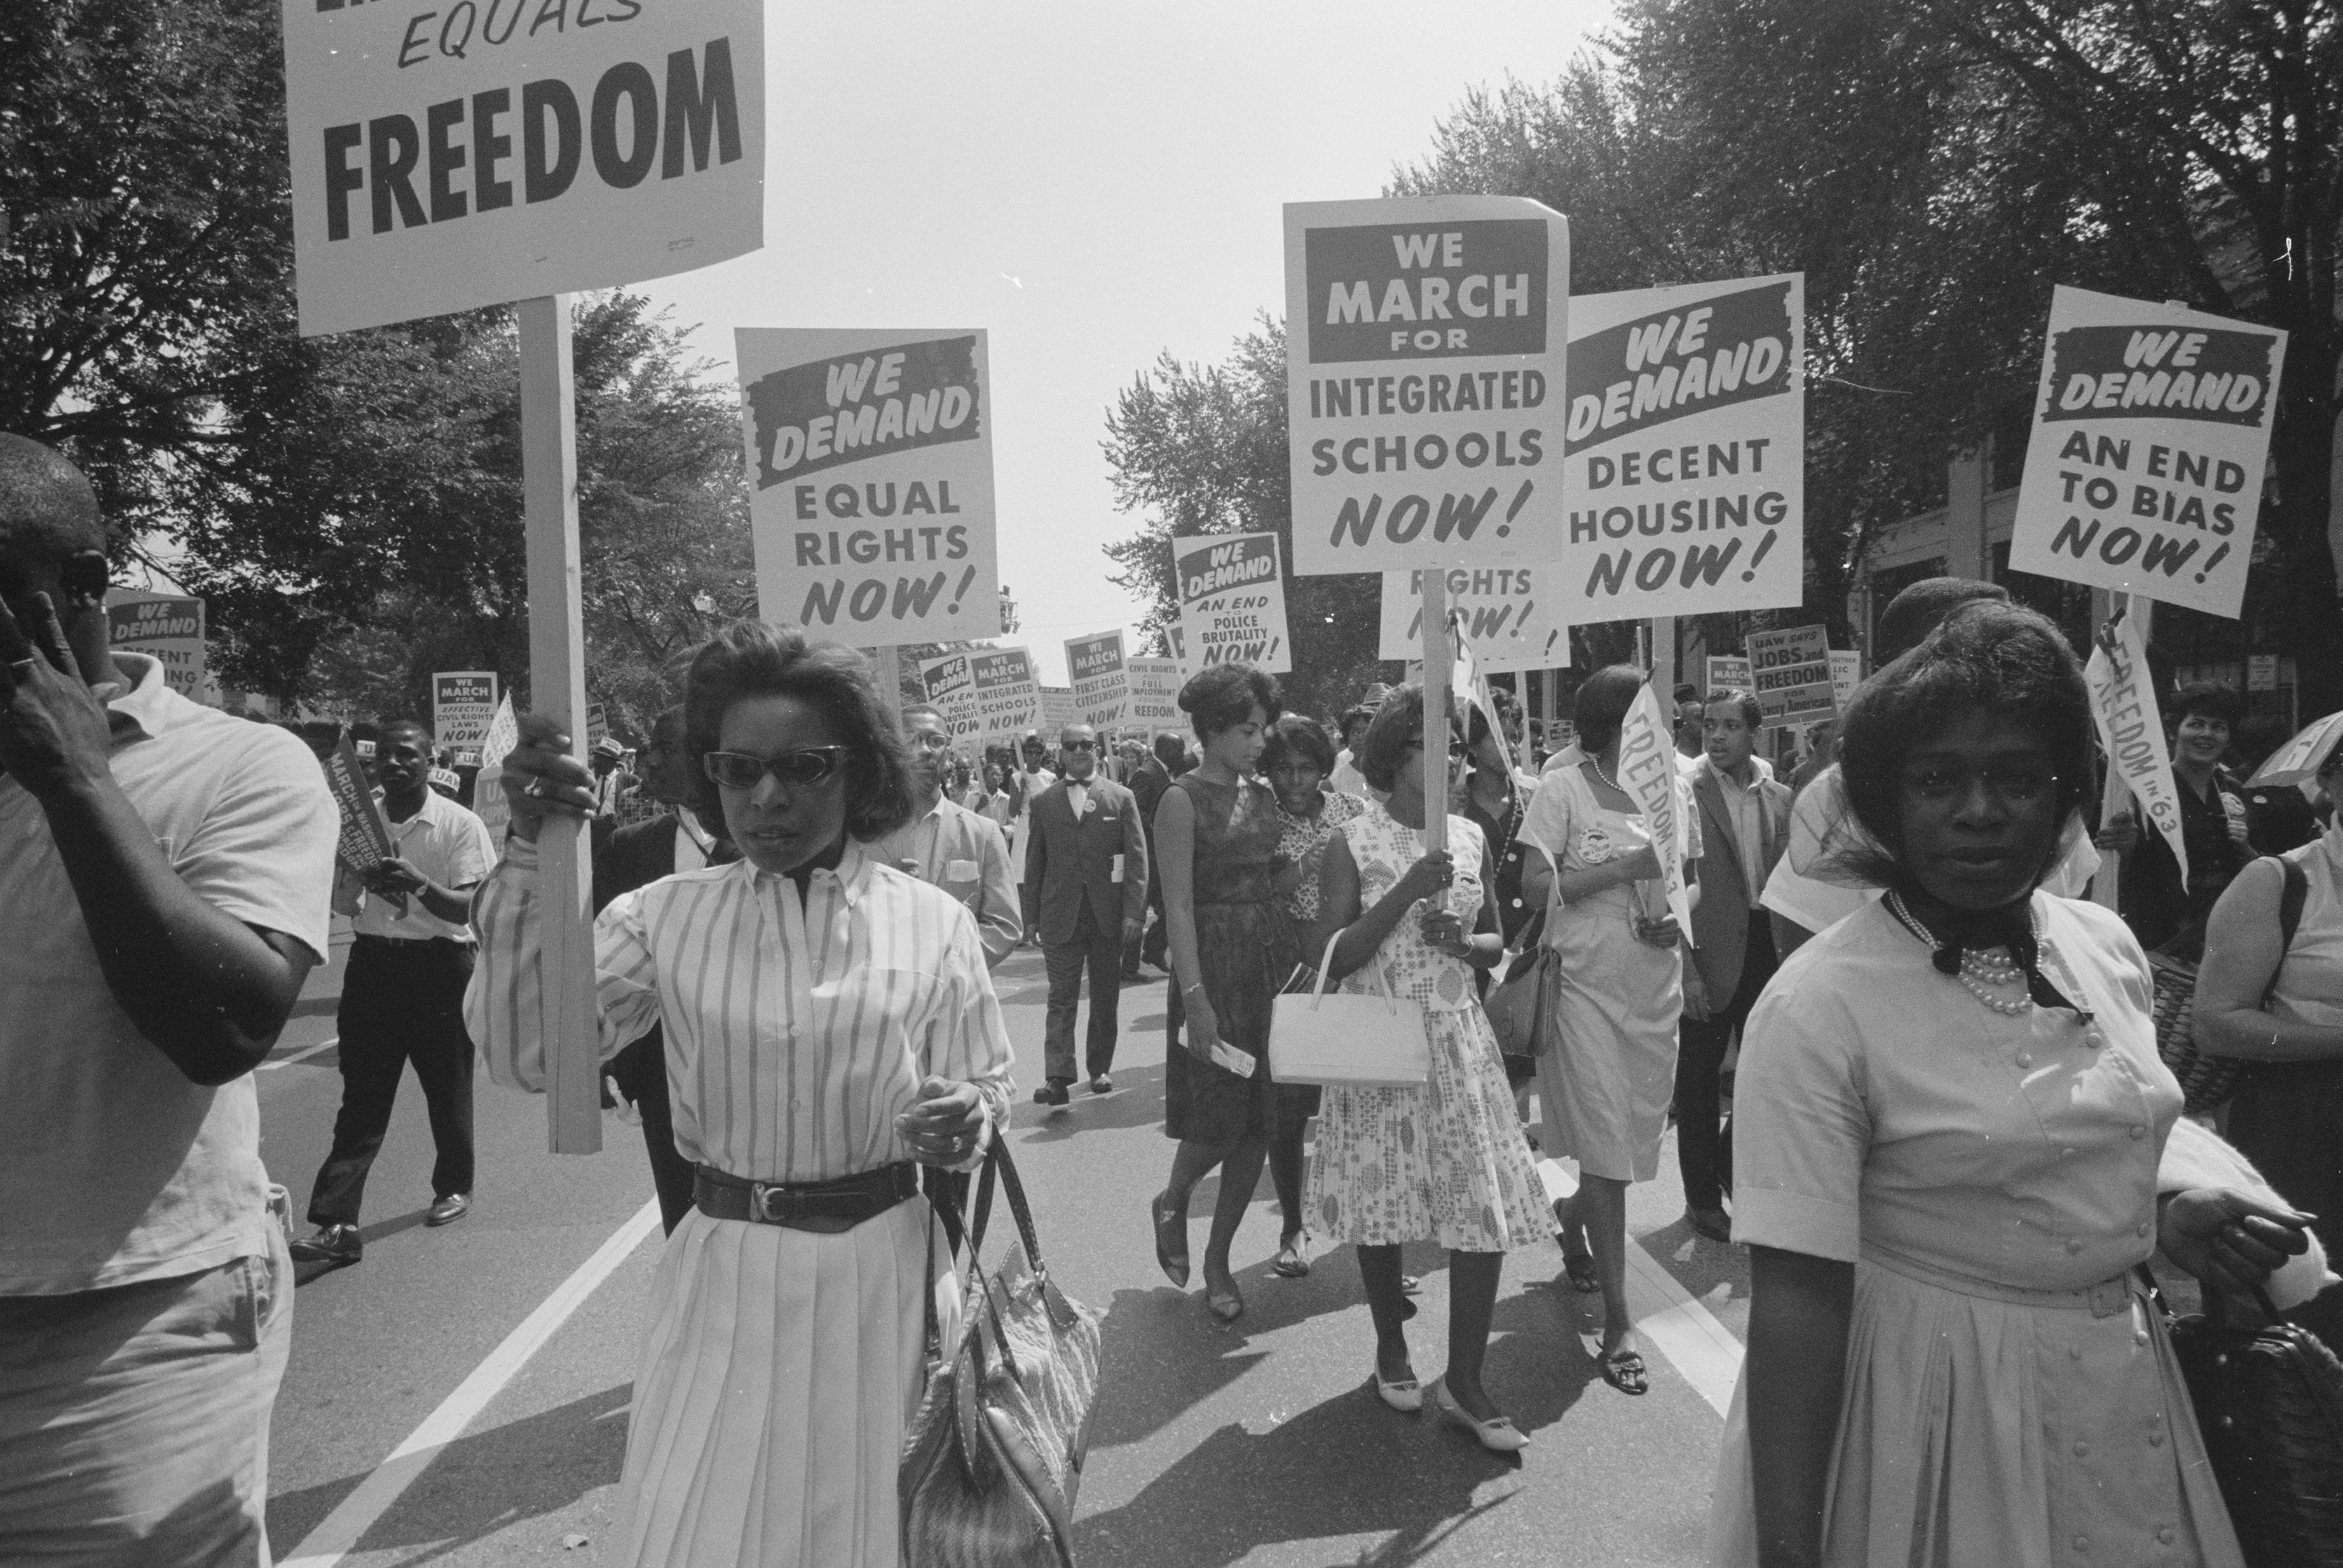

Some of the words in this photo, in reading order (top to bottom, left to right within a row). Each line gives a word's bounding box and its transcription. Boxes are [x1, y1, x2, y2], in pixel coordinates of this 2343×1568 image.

[324, 36, 742, 242] FREEDOM
[1392, 232, 1463, 270] WE
[1325, 273, 1529, 325] MARCH
[1391, 328, 1470, 351] FOR
[1625, 307, 1713, 372] WE
[2123, 330, 2208, 369] WE
[826, 352, 906, 408] WE
[1566, 337, 1784, 442] DEMAND
[2060, 371, 2262, 412] DEMAND
[1309, 369, 1547, 419] INTEGRATED
[772, 386, 972, 472] DEMAND
[1311, 428, 1544, 477] SCHOOLS
[1588, 438, 1770, 490] DECENT
[2059, 430, 2131, 471] AN
[2147, 445, 2245, 494] END
[795, 481, 960, 520] EQUAL
[2059, 470, 2118, 510] TO
[2131, 484, 2236, 536] BIAS
[1329, 479, 1534, 549] NOW!
[1570, 491, 1788, 544] HOUSING
[795, 525, 968, 567] RIGHTS
[1210, 542, 1245, 568] WE
[2050, 515, 2230, 585] NOW!
[1585, 529, 1777, 598] NOW!
[1188, 556, 1272, 597] DEMAND
[1411, 569, 1531, 596] RGHTS
[800, 564, 976, 626] NOW!
[1197, 598, 1226, 613] AN
[1231, 596, 1268, 609] END
[138, 603, 172, 620] WE
[1214, 615, 1258, 630] POLICE
[1407, 600, 1534, 640] W!
[115, 617, 197, 640] DEMAND
[1202, 627, 1268, 644] BRUTALITY
[1755, 636, 1785, 648] UAW
[1789, 631, 1817, 644] SAYS
[990, 655, 1008, 666] WE
[1076, 650, 1119, 670] MARCH
[1088, 642, 1103, 654] WE
[1203, 636, 1280, 666] NOW!
[1755, 646, 1802, 667] JOBS
[943, 657, 964, 677] WE
[978, 662, 1025, 679] MARCH
[1091, 665, 1107, 675] FOR
[1129, 664, 1148, 672] CIVIL
[1151, 665, 1177, 674] RIGHTS
[1714, 670, 1751, 679] MARCH
[1756, 665, 1829, 691] FREEDOM
[441, 687, 488, 697] MARCH
[456, 678, 473, 686] WE
[978, 683, 1034, 701] INTEGRATED
[1076, 680, 1100, 695] FIRST
[1101, 674, 1126, 688] CLASS
[1784, 690, 1807, 698] FOR
[938, 694, 954, 706] AN
[959, 692, 973, 701] EN
[948, 702, 976, 714] POLICE
[980, 697, 1036, 714] SCHOOLS
[1076, 686, 1129, 709] CITIZENSHIP
[437, 714, 460, 722] CIVIL
[943, 711, 978, 724] BRUTALIT
[989, 709, 1036, 730] NOW!
[1086, 702, 1127, 726] NOW!
[1135, 705, 1175, 718] REEDOM
[2094, 640, 2158, 779] FREEDOM
[2143, 780, 2159, 797] IN
[1620, 712, 1674, 847] FREEDOM
[331, 752, 359, 803] MARCH
[356, 810, 383, 859] WASHINGTO
